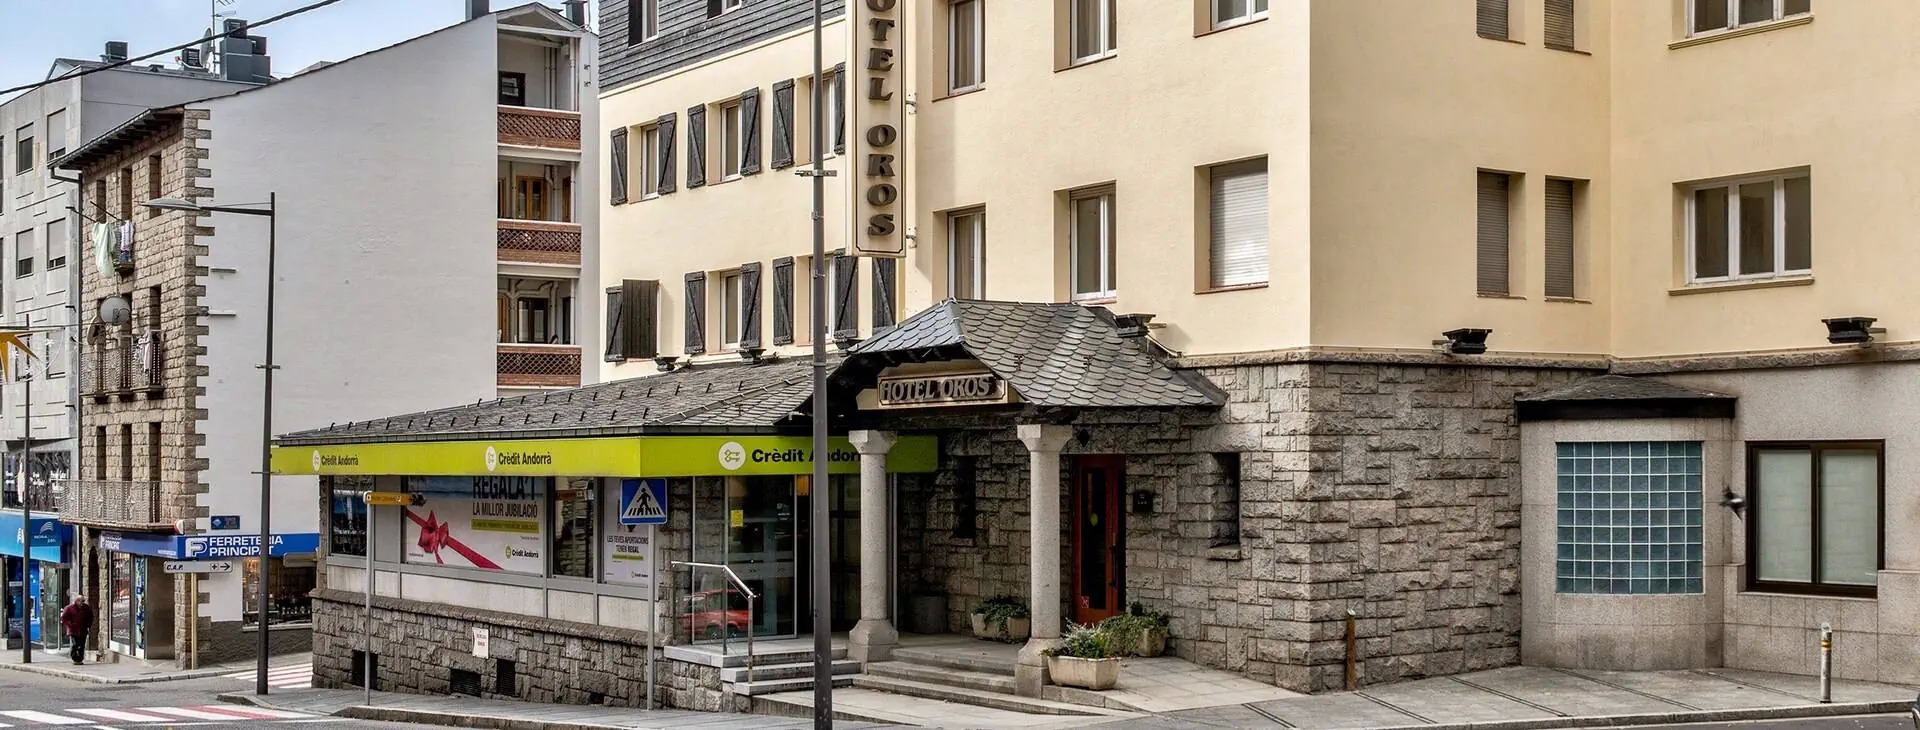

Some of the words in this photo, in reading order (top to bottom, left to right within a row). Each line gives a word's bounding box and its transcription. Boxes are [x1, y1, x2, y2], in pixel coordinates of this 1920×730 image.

[866, 124, 898, 236] OROS
[882, 379, 935, 401] HOTEL
[940, 376, 991, 398] OROS
[338, 454, 359, 466] Andorrà
[498, 451, 520, 465] Crèdit
[522, 451, 552, 465] Andorrà
[751, 448, 804, 462] Crèdit
[473, 501, 480, 516] LA
[481, 502, 504, 517] MILLOR
[505, 501, 538, 518] JUBILACIÓ
[209, 535, 284, 547] FERRETEIA
[209, 545, 274, 557] PRINCIPT
